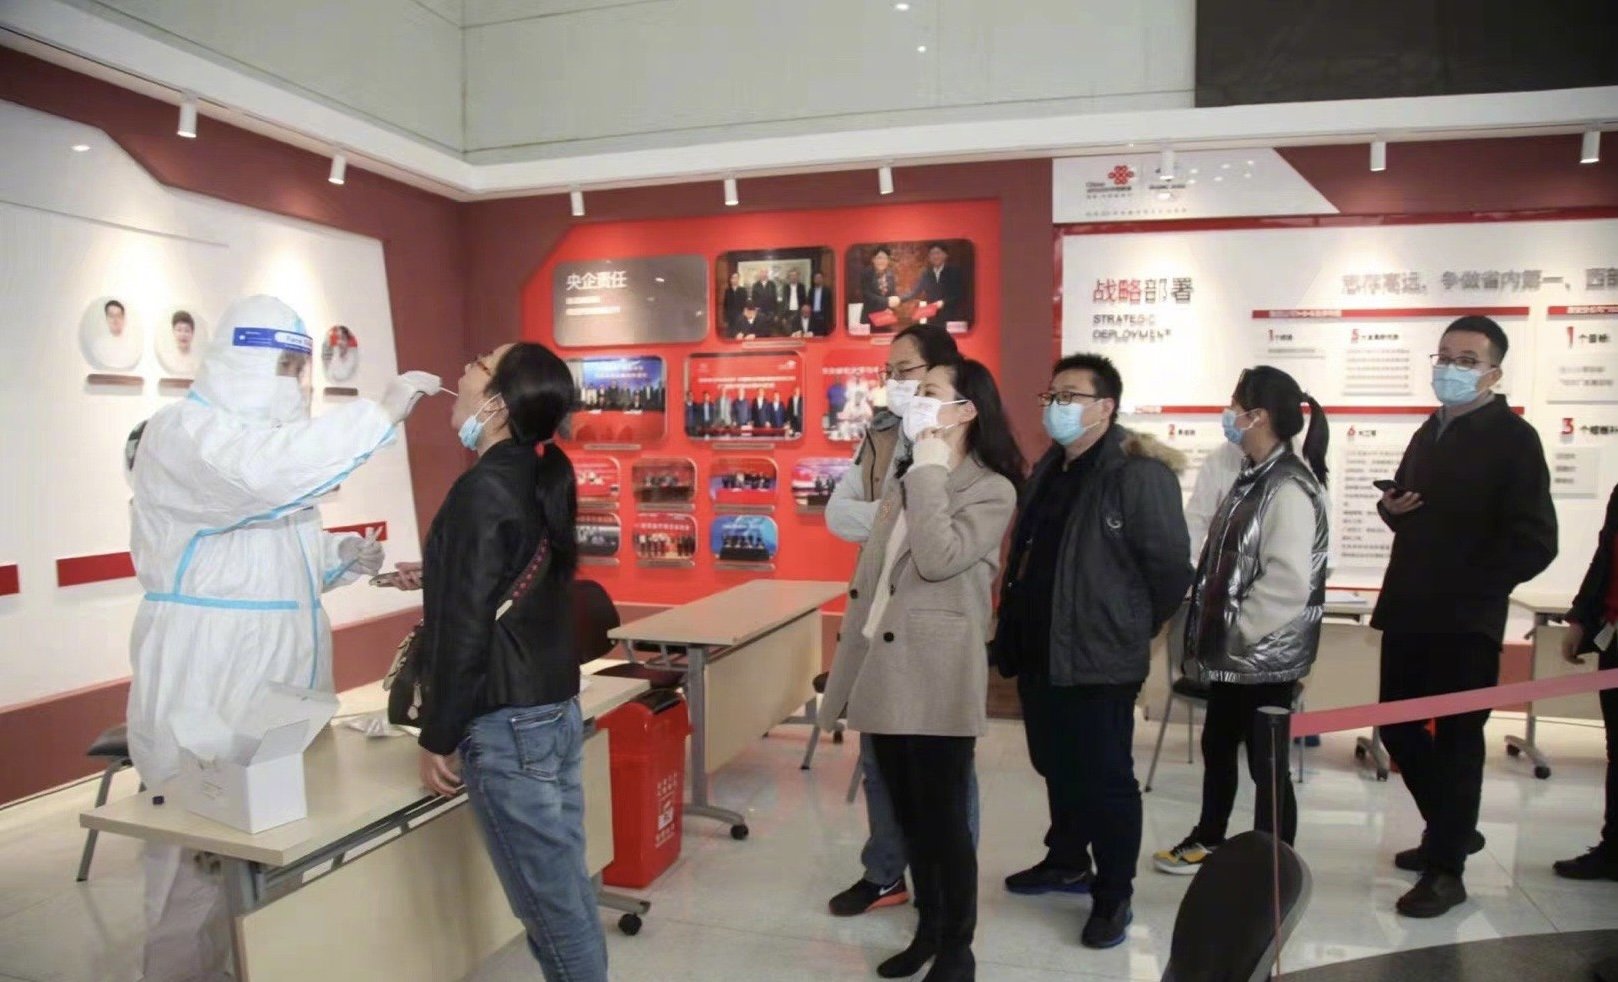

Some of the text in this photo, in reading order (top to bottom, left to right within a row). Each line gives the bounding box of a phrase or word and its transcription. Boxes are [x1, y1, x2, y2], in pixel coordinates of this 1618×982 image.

[566, 270, 628, 291] 央企责任
[1093, 278, 1194, 303] 战略部署
[1093, 314, 1155, 325] STRATEGC
